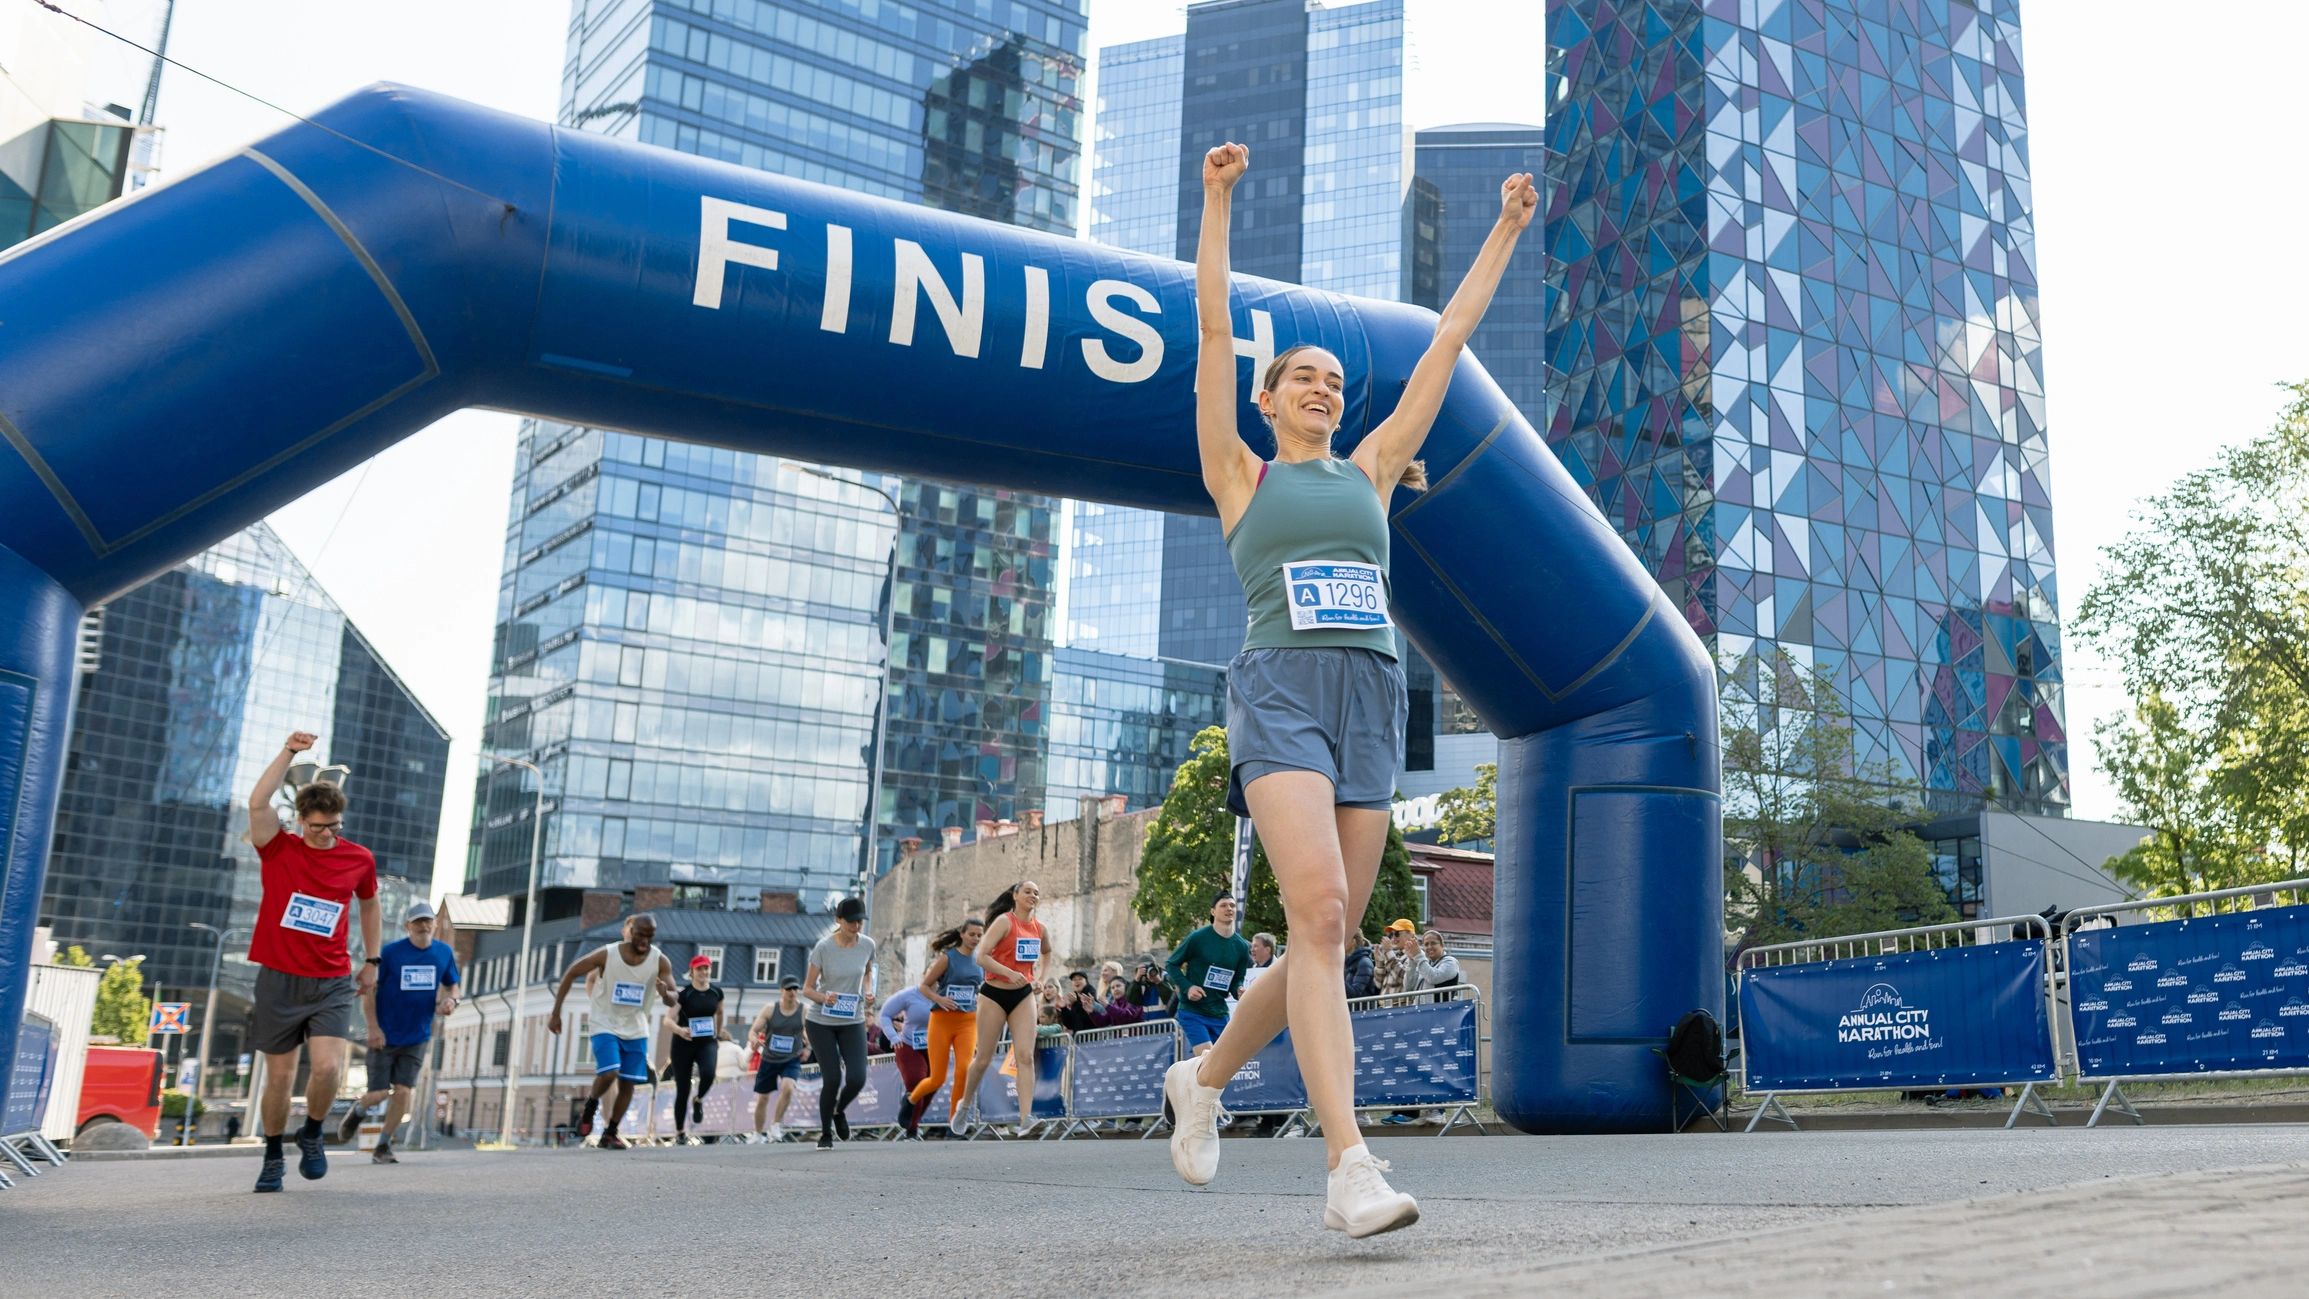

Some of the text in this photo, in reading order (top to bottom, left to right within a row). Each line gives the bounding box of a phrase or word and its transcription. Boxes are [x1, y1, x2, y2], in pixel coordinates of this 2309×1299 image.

[692, 195, 1275, 403] FINISH
[1301, 583, 1376, 610] A 1296
[304, 908, 336, 926] 3047
[1838, 1010, 1928, 1028] ANNUAL CITY
[1838, 1024, 1930, 1042] MARATHON
[1868, 1048, 1883, 1059] Run
[1884, 1046, 1892, 1057] for
[1894, 1042, 1914, 1055] health
[1915, 1040, 1928, 1052] and
